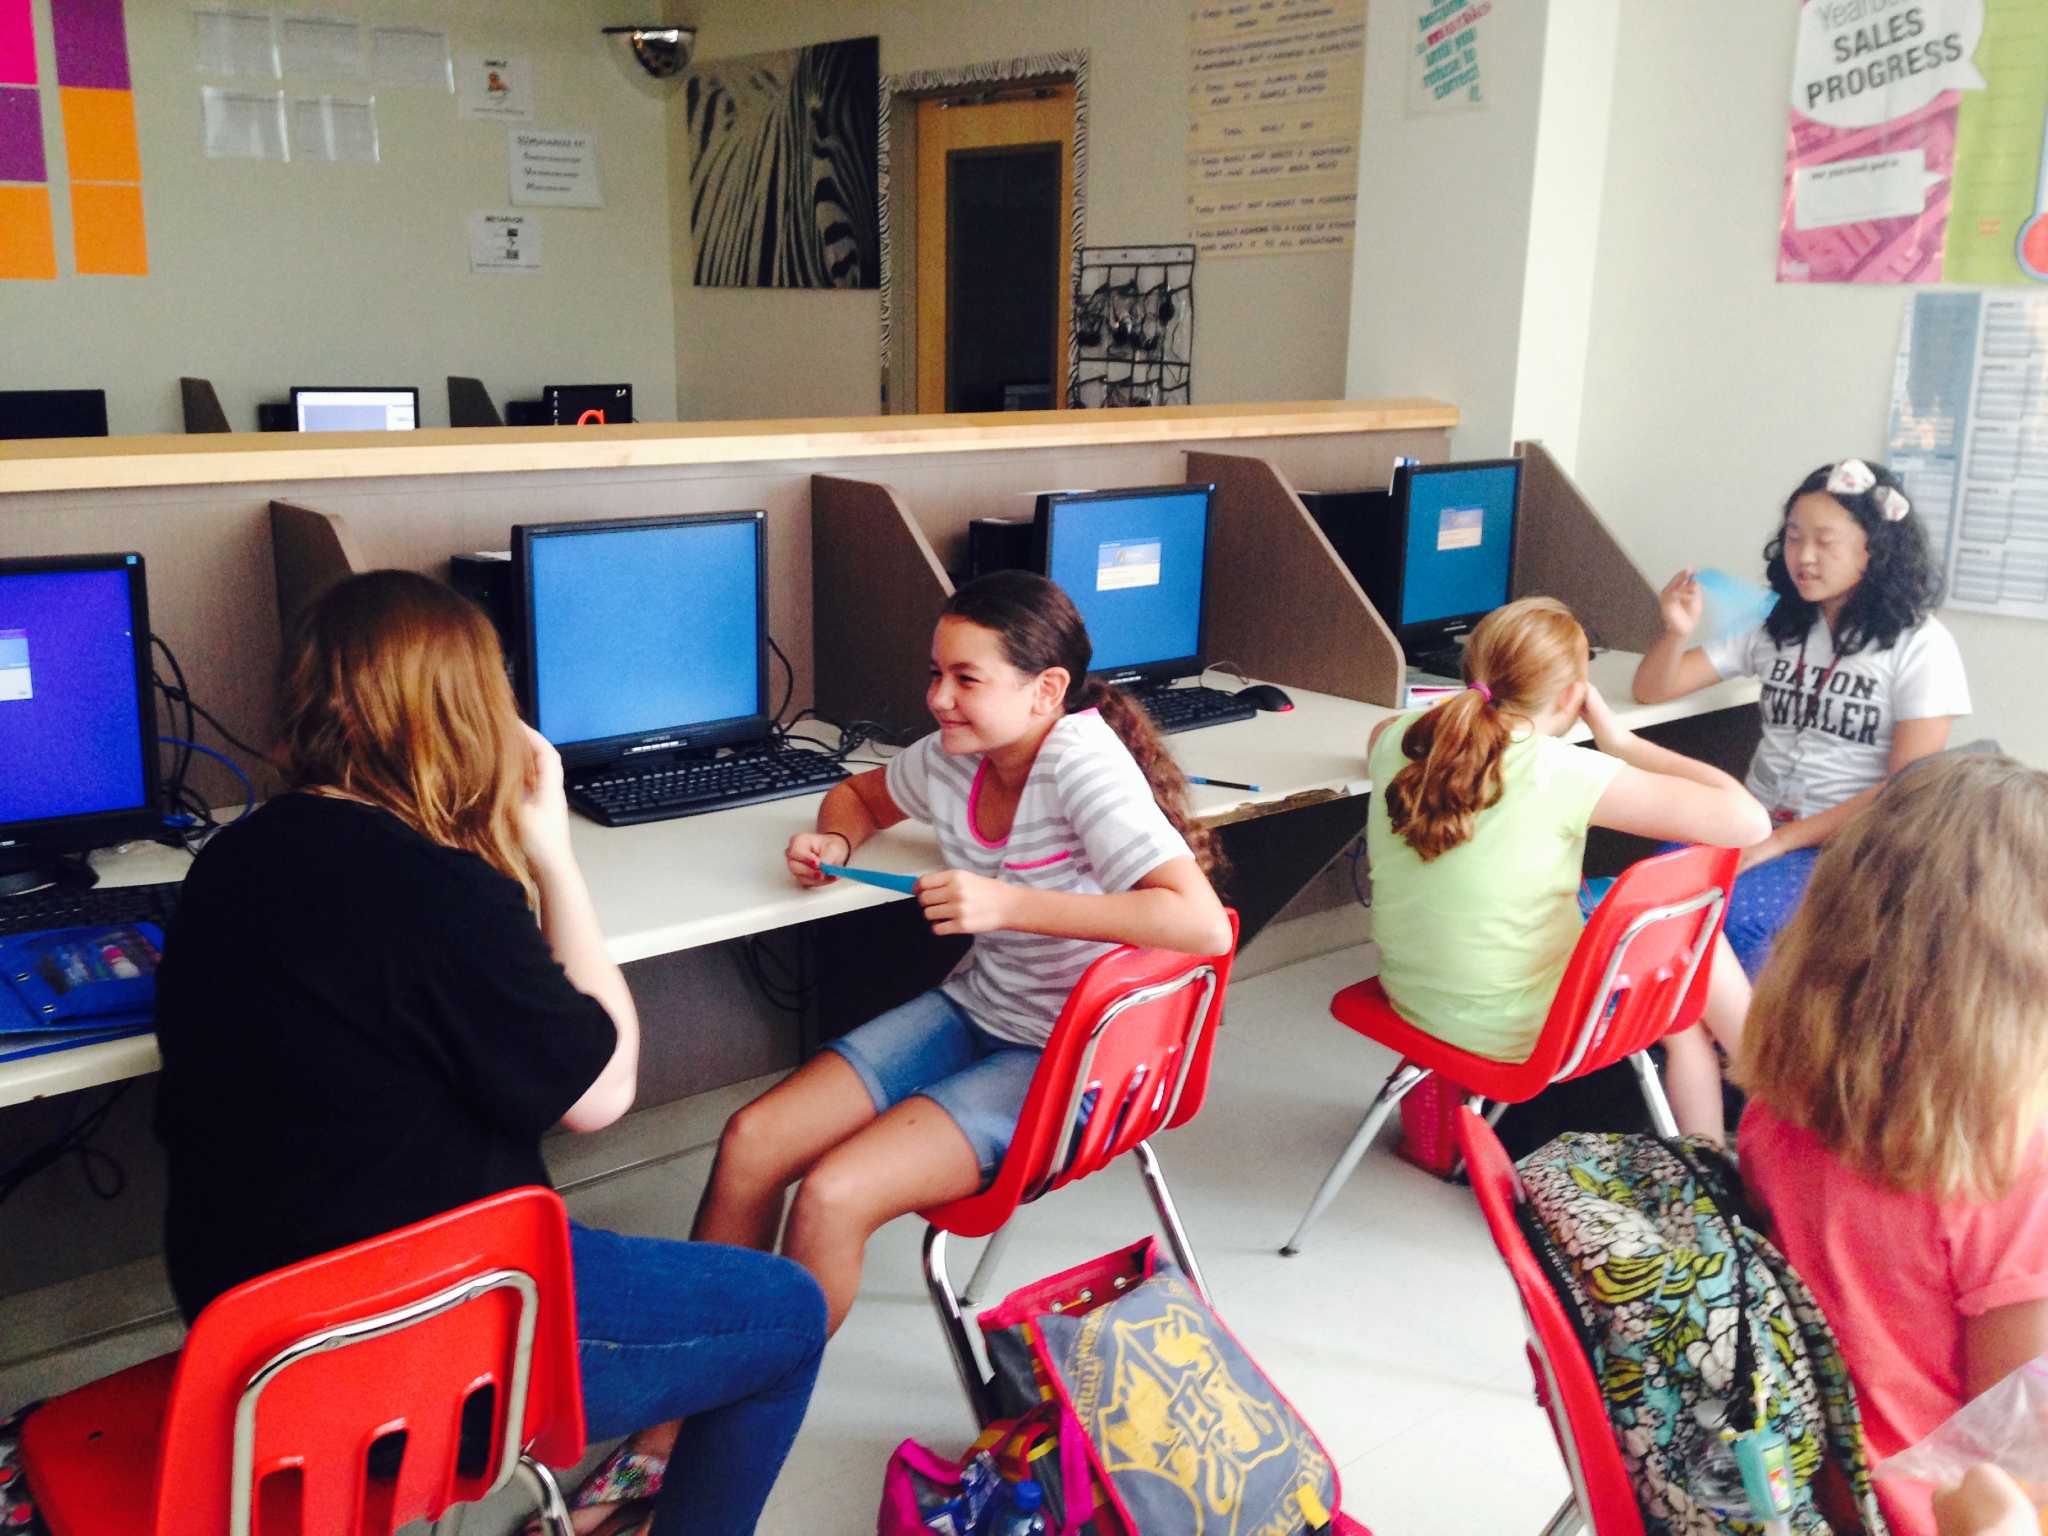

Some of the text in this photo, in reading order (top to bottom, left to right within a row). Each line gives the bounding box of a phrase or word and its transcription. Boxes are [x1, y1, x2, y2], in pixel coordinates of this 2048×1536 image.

[1833, 7, 1924, 63] SALES
[1806, 33, 1963, 109] PROGRESS
[1769, 658, 1879, 702] BATON
